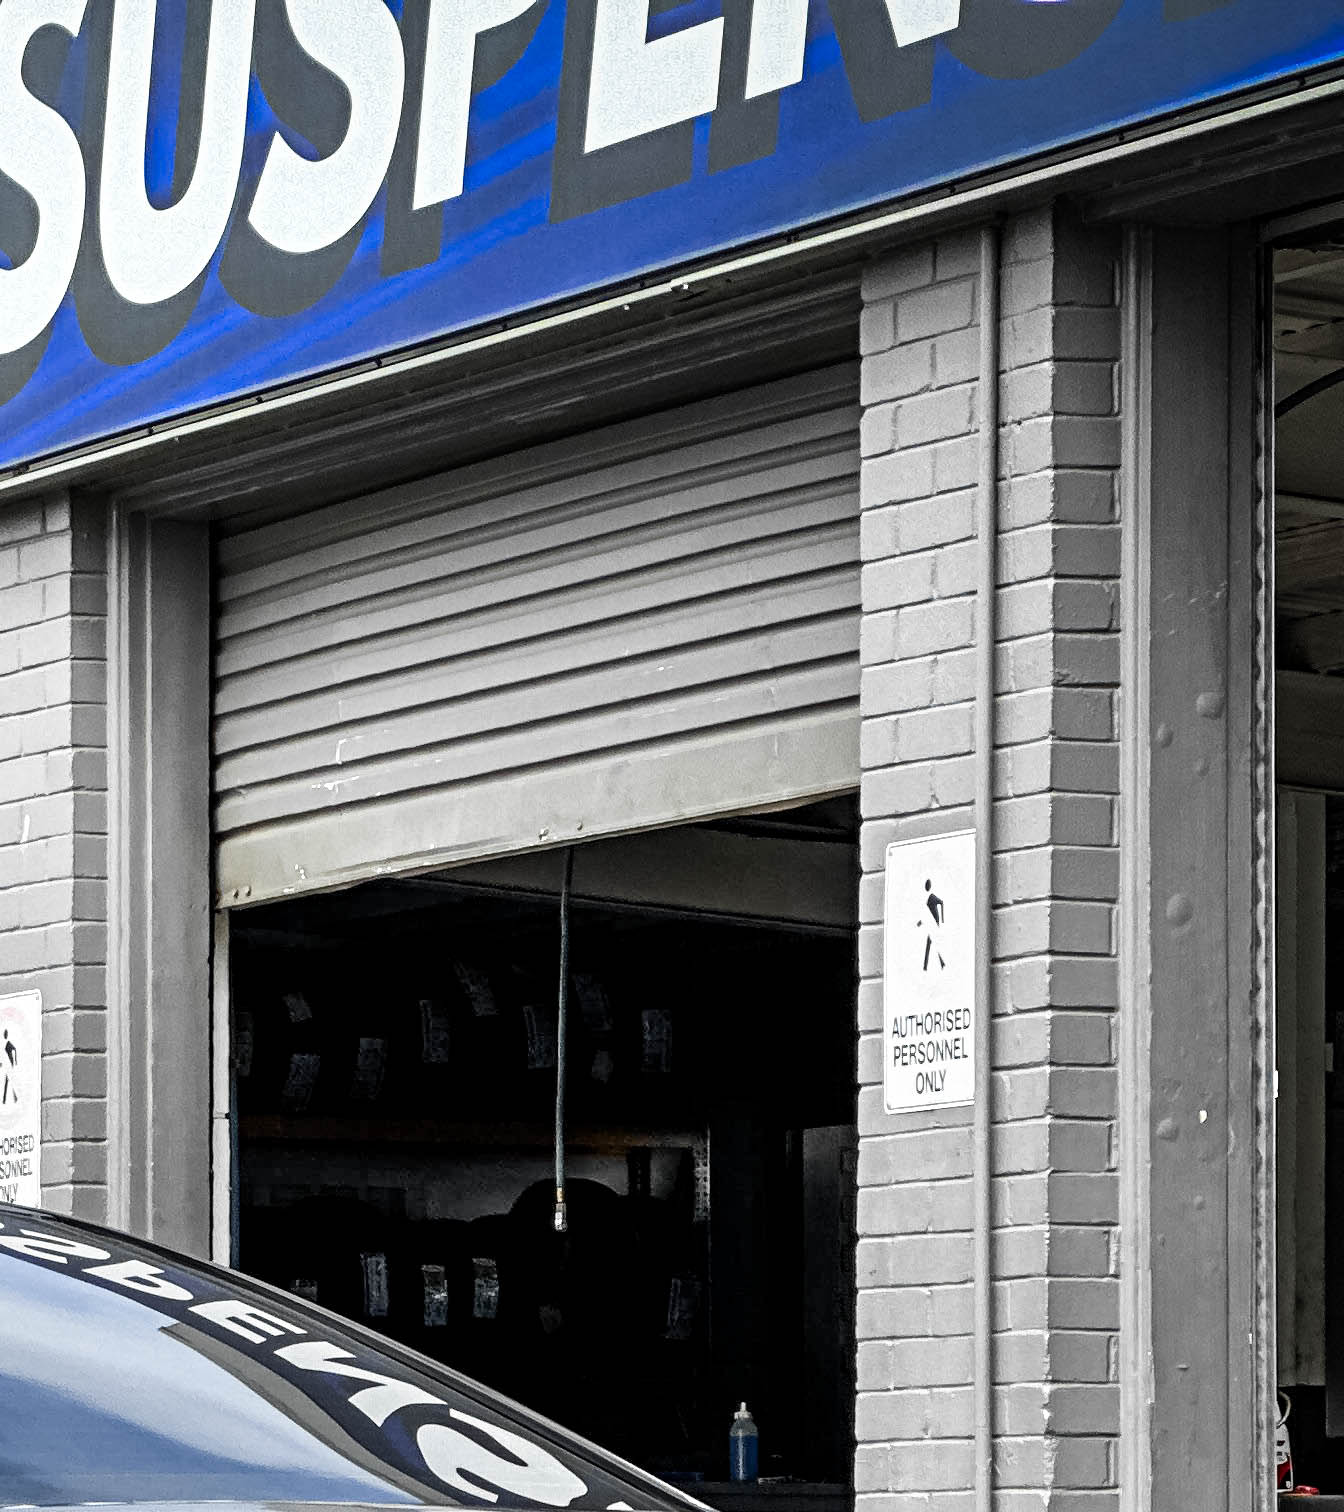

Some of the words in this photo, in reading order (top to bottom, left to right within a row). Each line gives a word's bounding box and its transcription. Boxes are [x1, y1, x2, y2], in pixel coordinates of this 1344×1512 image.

[892, 1008, 971, 1037] AUTHORISED
[893, 1037, 968, 1067] PERSONNEL
[915, 1069, 947, 1095] ONLY
